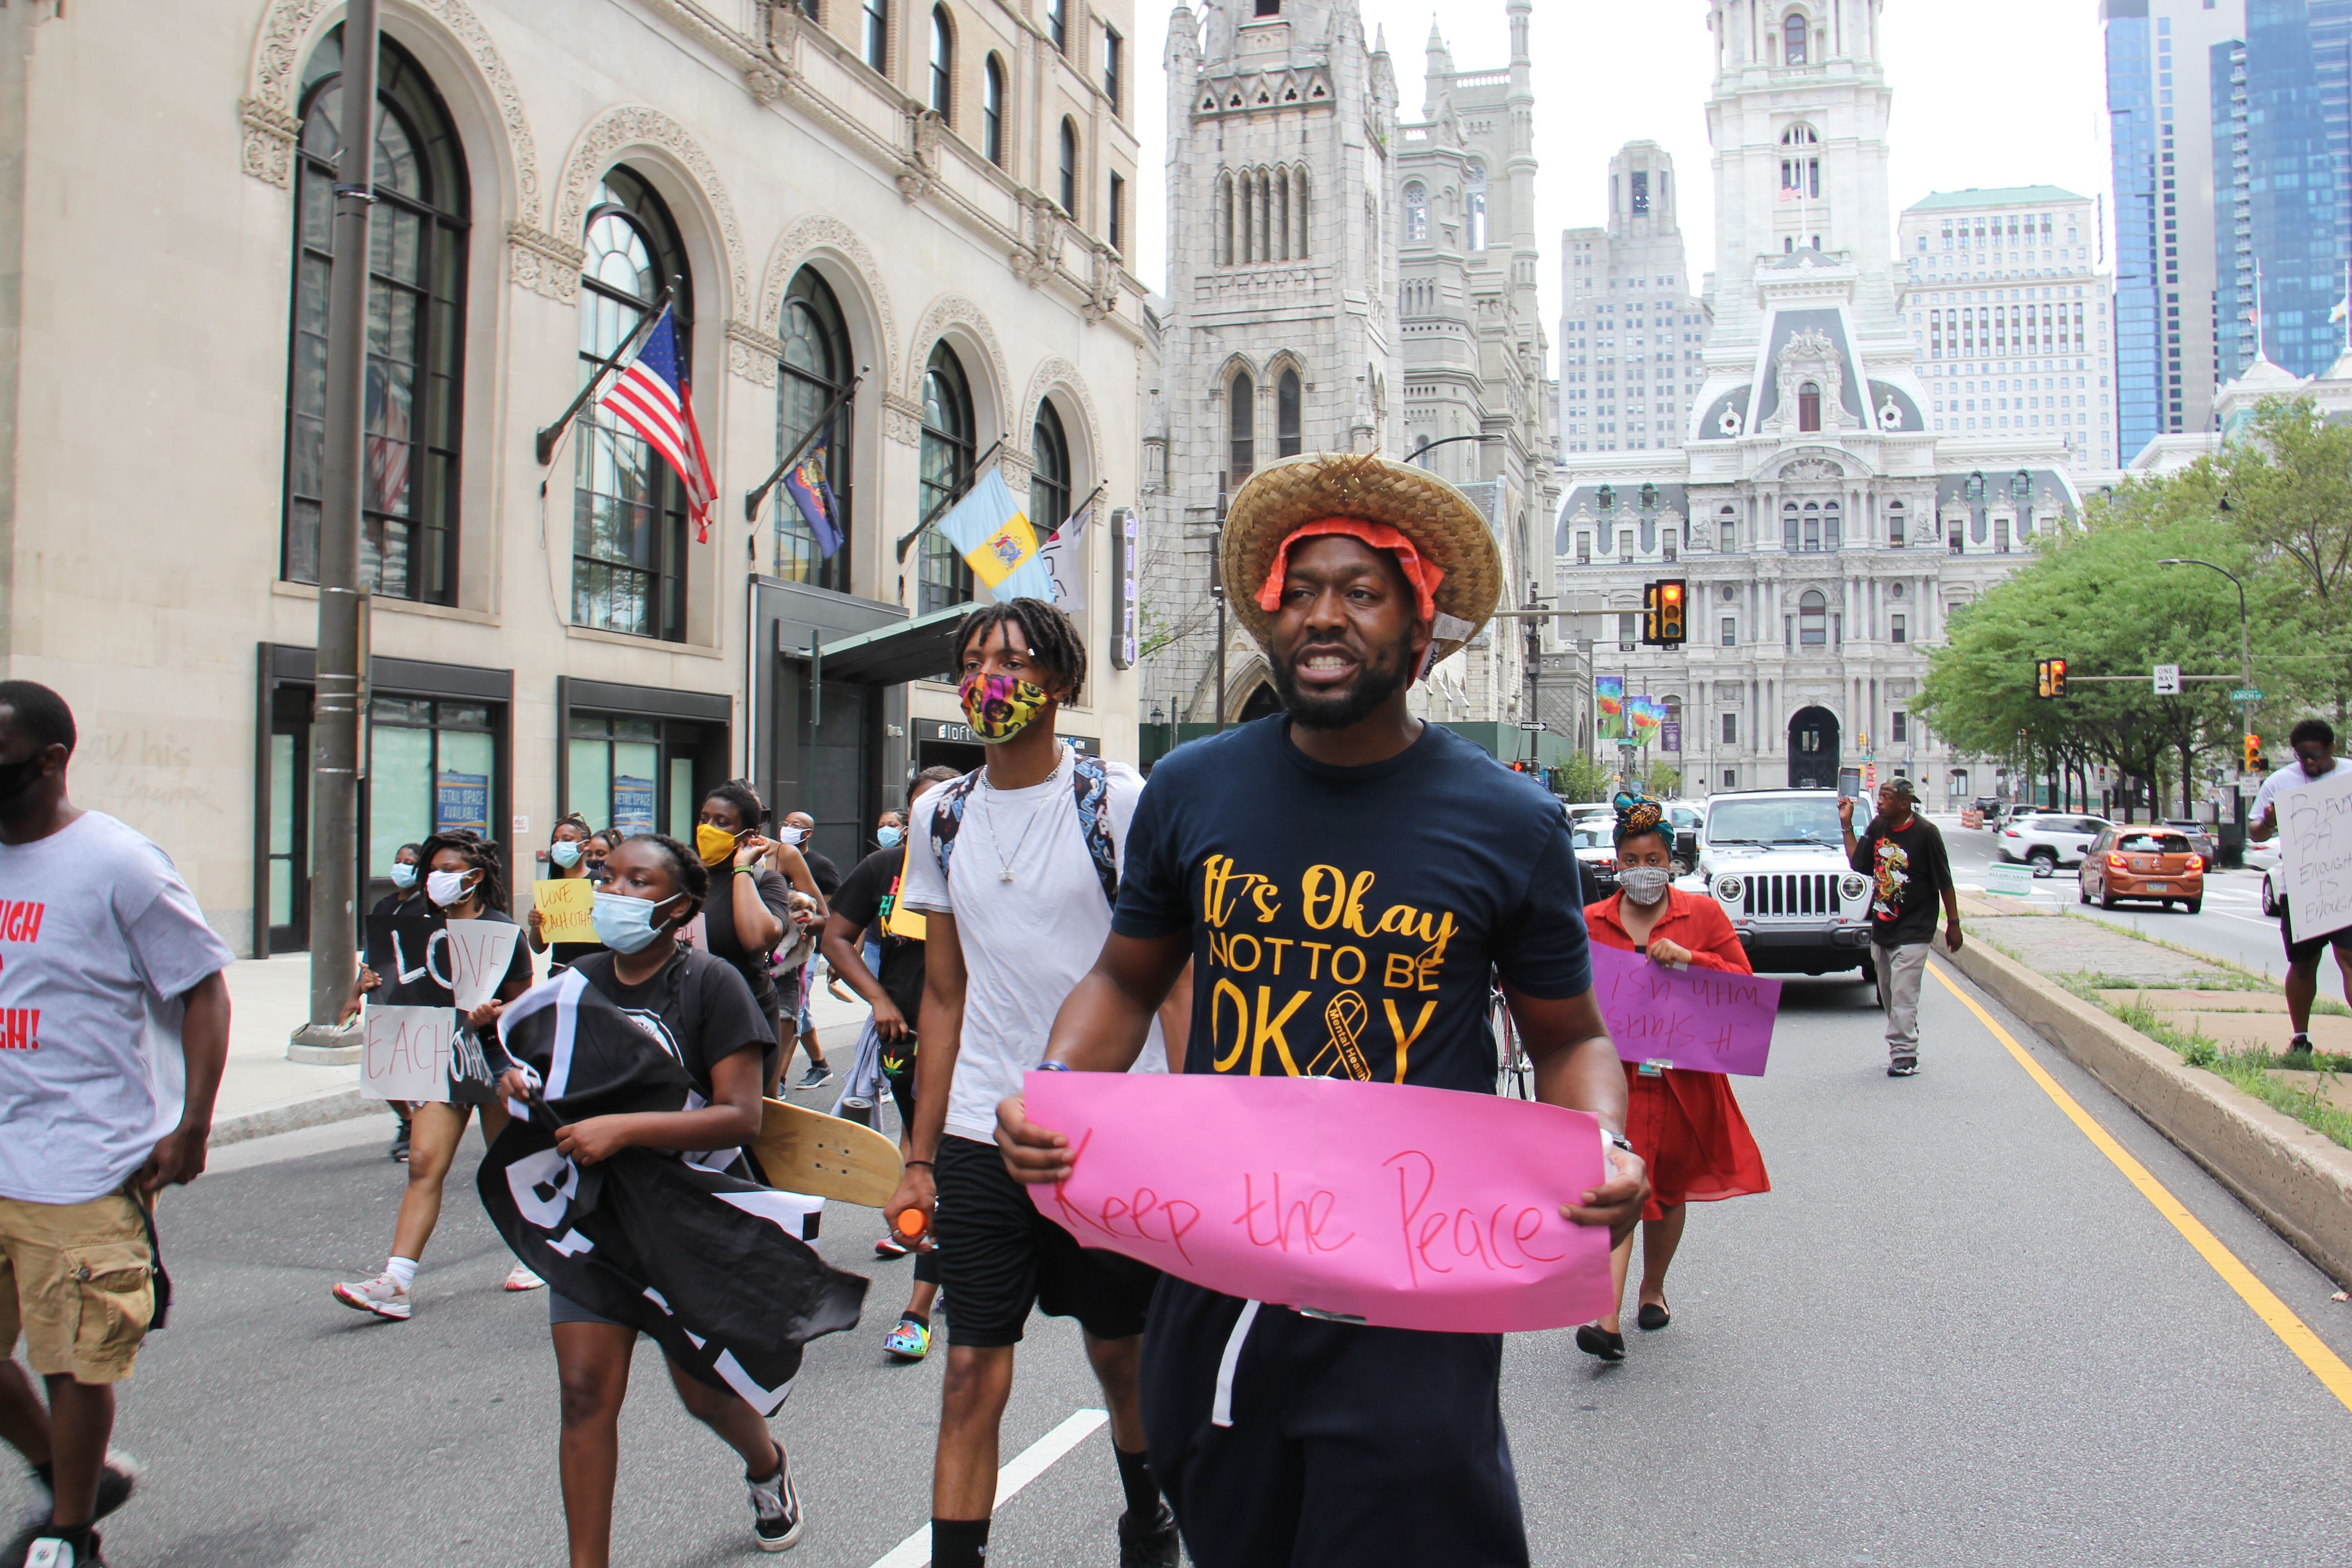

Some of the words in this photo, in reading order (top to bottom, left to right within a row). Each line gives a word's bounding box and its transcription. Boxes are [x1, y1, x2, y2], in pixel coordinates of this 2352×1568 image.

[439, 789, 461, 804] RETAIL
[463, 790, 485, 805] SPACE
[444, 805, 479, 820] AVAILABLE
[540, 882, 573, 908] LOVE
[2317, 880, 2338, 897] IS
[542, 911, 568, 934] EACH
[1203, 854, 1281, 927] It's
[1302, 864, 1459, 962] Okay
[391, 928, 506, 992] LOVE
[1208, 931, 1294, 975] NOT
[1301, 941, 1366, 985] TO
[1384, 952, 1445, 992] BE
[1329, 1009, 1351, 1047] Mental
[368, 1014, 451, 1084] EACH
[1346, 1048, 1366, 1081] Health
[1054, 1128, 1200, 1267] Keep
[1233, 1172, 1355, 1254] the
[1382, 1150, 1566, 1289] Peace
